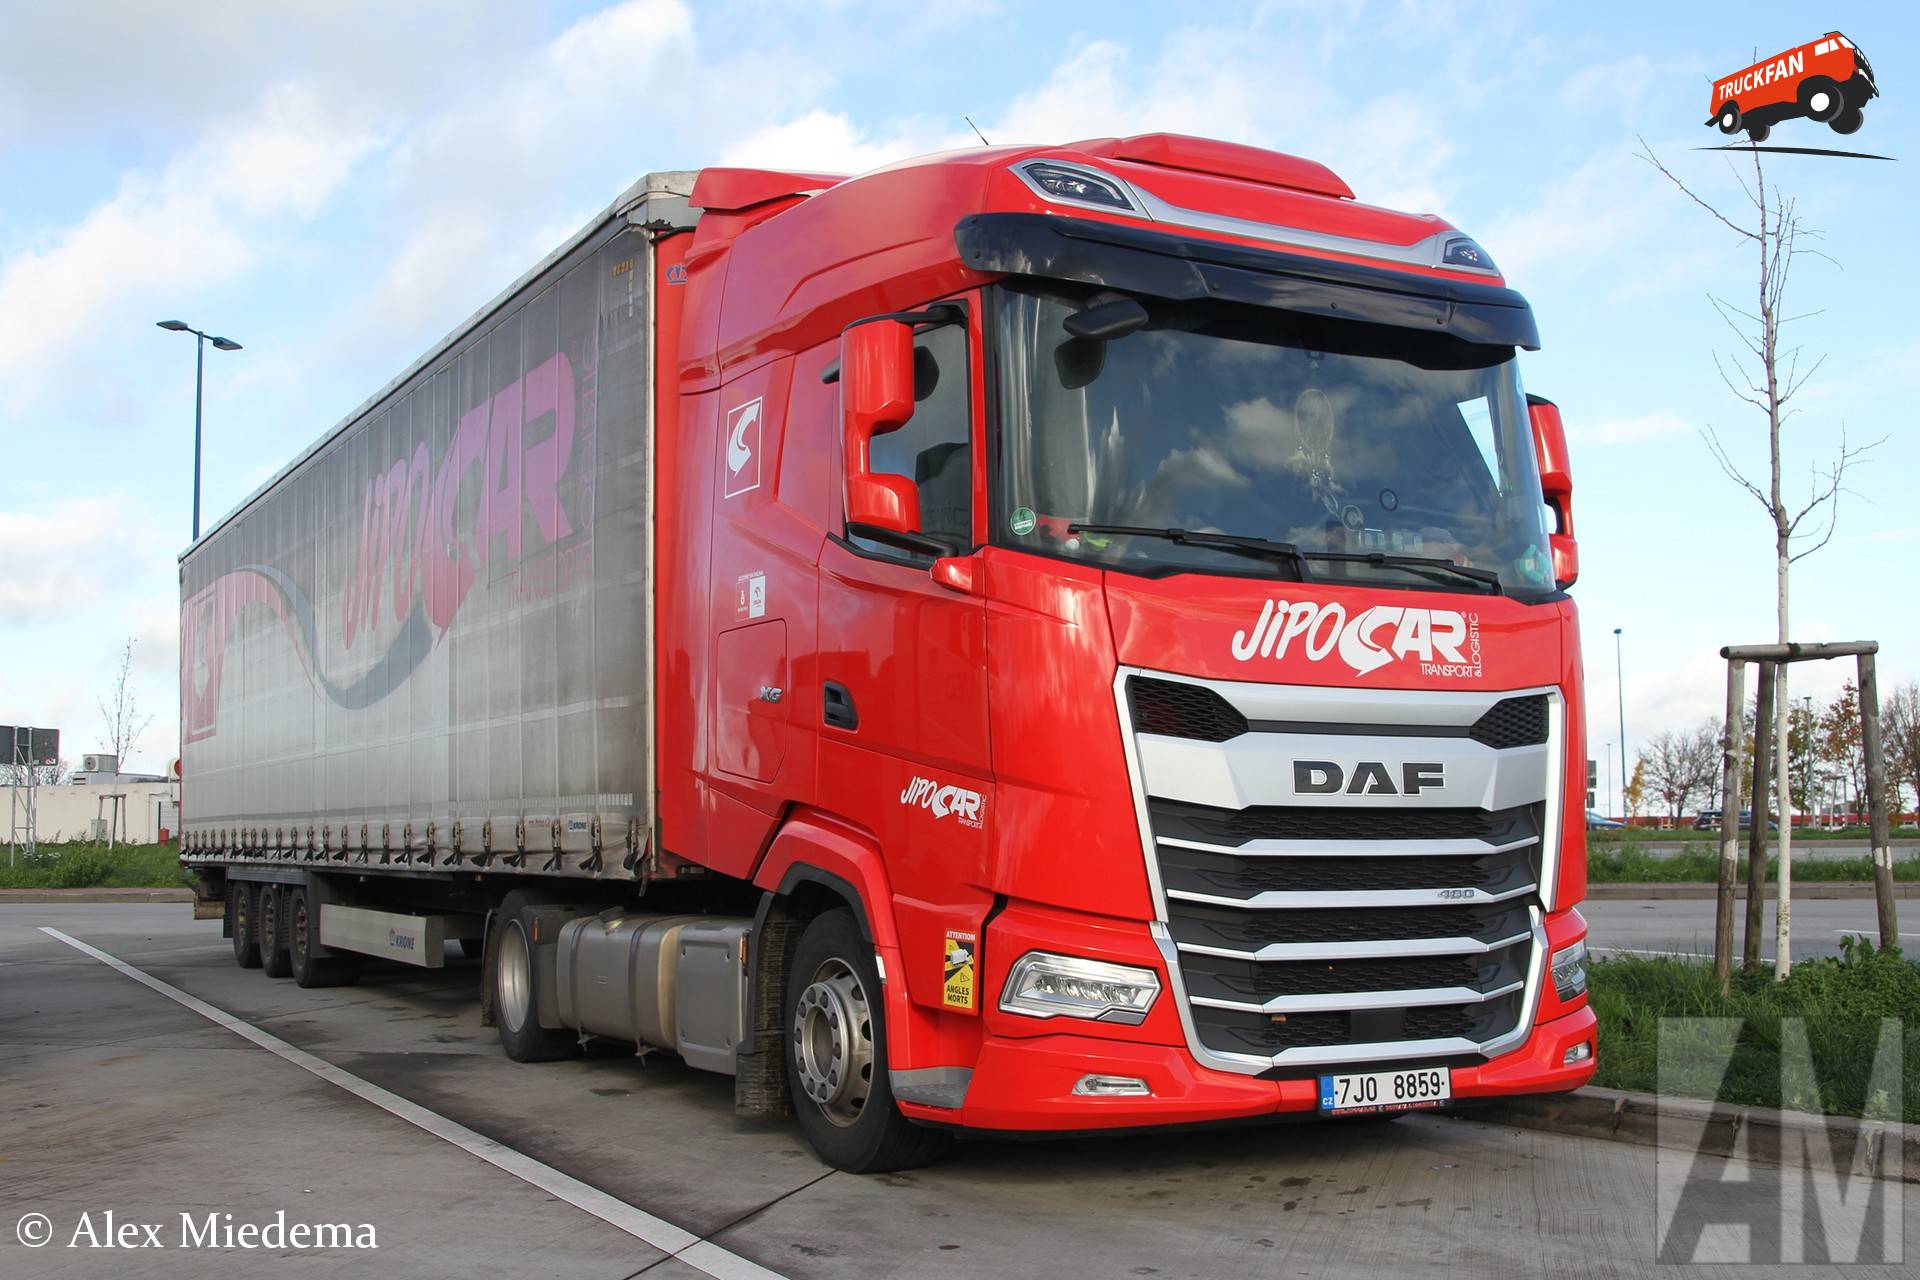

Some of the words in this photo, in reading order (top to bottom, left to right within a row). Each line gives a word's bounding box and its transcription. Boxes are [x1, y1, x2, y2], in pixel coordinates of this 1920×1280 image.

[1420, 662, 1474, 678] TRANSPORT
[1292, 759, 1445, 796] DAF
[945, 930, 976, 941] ATTENTION
[946, 985, 970, 996] ANGLES
[947, 993, 968, 1004] MORTS
[1394, 1071, 1441, 1099] 8859
[1322, 1097, 1334, 1106] CZ
